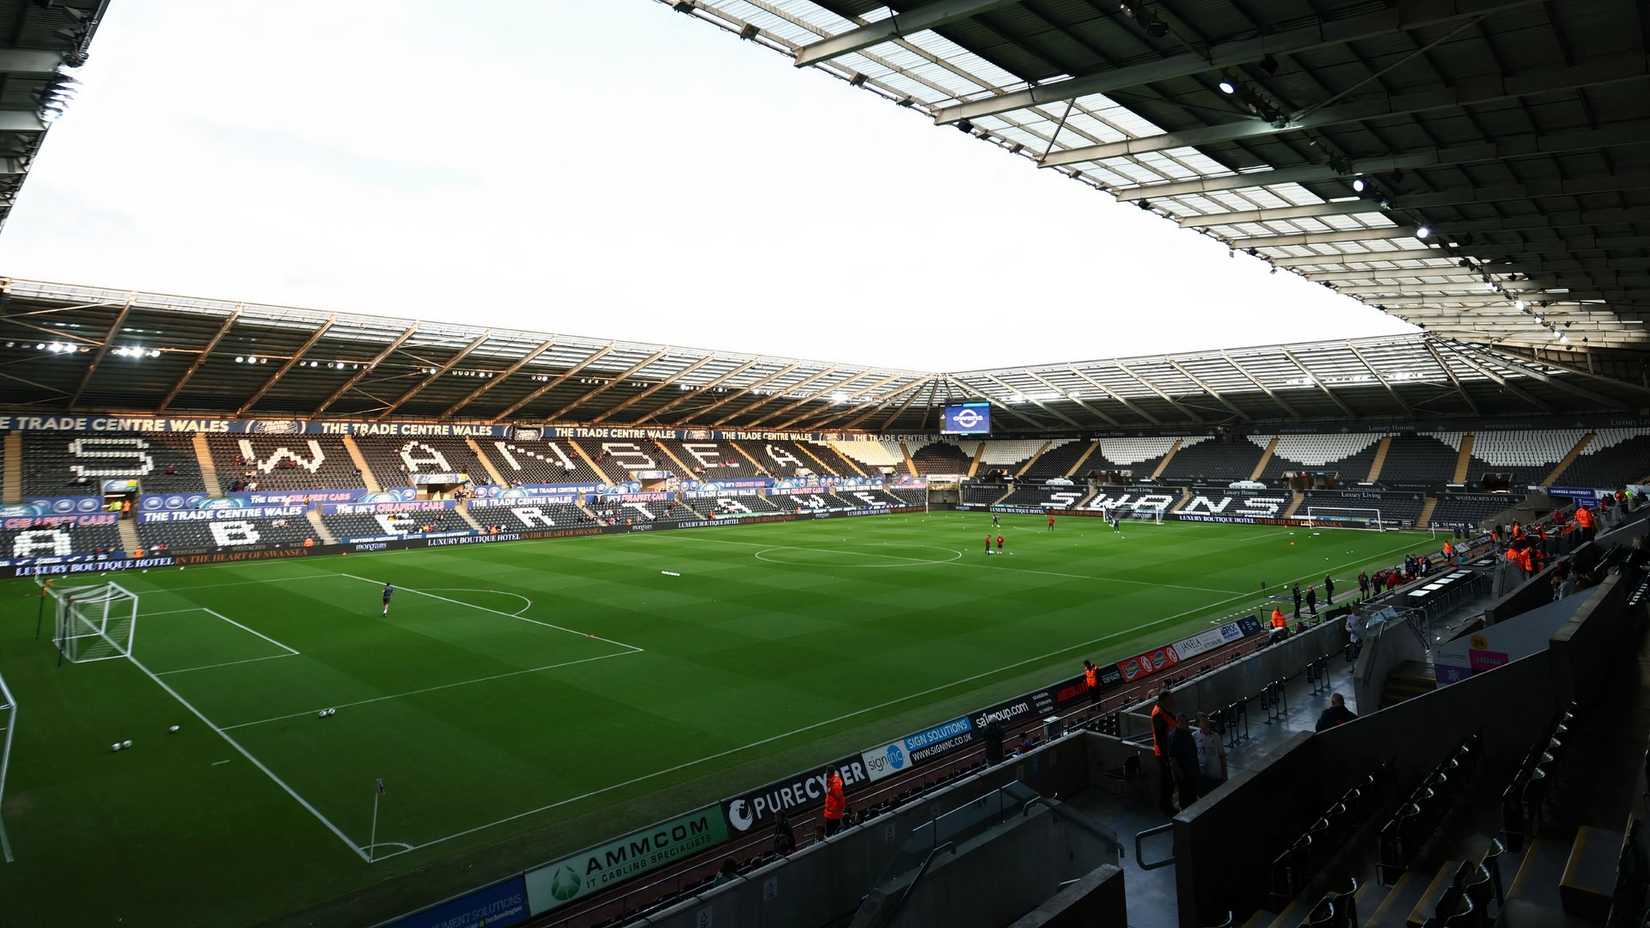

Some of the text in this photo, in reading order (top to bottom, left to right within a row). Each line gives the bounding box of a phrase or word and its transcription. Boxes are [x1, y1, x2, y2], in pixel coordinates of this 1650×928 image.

[16, 416, 87, 430] TRADE
[92, 418, 167, 432] CENTRE
[169, 420, 229, 433] WALES
[322, 422, 493, 437] THE TRADE CENTRE WALES
[555, 427, 676, 439] THE TRADE CENTRE WALES
[722, 431, 736, 440] THE
[737, 432, 762, 440] TRADE
[763, 432, 789, 441] CENTRE
[790, 433, 812, 441] WALES
[869, 434, 895, 442] TRADE
[897, 434, 928, 442] CENTRE
[930, 434, 959, 442] WALES
[472, 496, 572, 507] THE TRADE CENTRE WALES
[144, 507, 302, 522] THE TRADE CENTRE WALES
[428, 536, 459, 547] LUXURY
[459, 535, 496, 545] BOUTIQUE
[497, 533, 521, 541] HOTEL
[15, 557, 175, 577] LUXURY BOUTIQUE HOTEL
[908, 718, 968, 749] SIGN SOLUTIONS
[911, 732, 973, 762] WWW.SIGNINC.CO.UK
[753, 761, 866, 820] PURECYER
[586, 816, 709, 876] AMMCOM
[586, 833, 713, 889] IT CABLING SPECIALISTS
